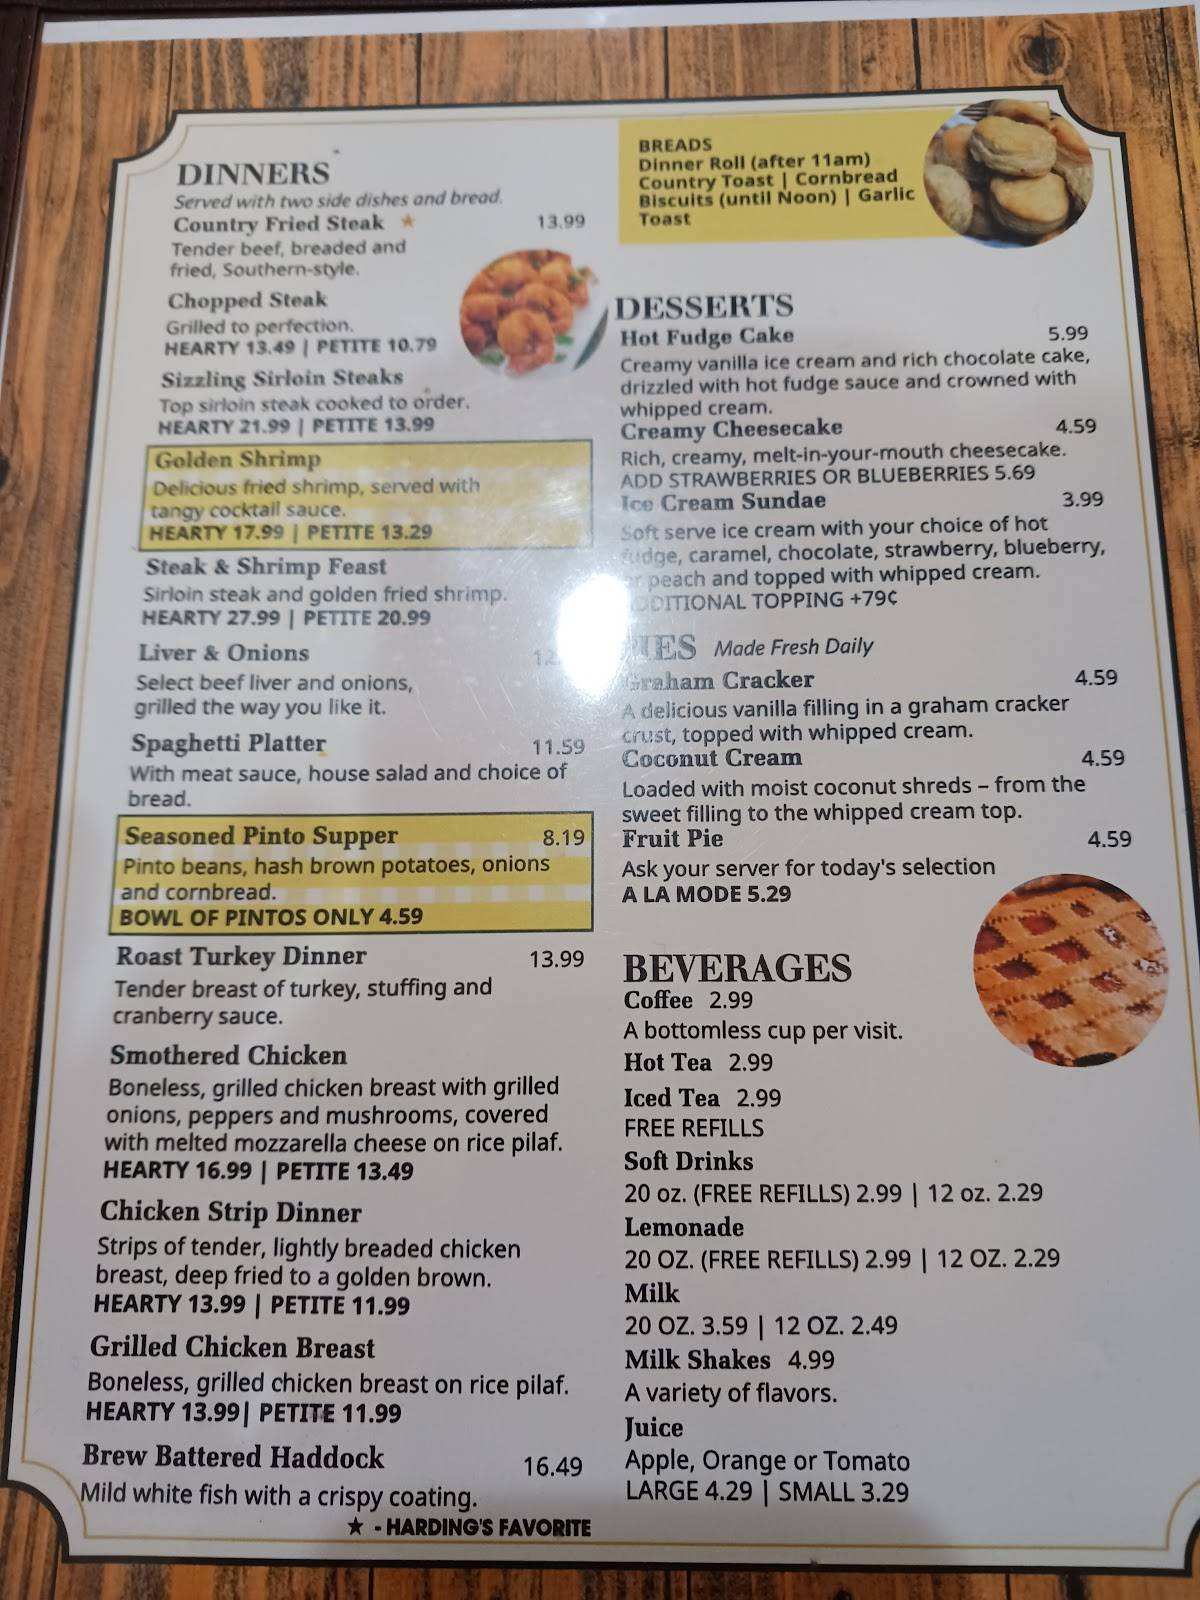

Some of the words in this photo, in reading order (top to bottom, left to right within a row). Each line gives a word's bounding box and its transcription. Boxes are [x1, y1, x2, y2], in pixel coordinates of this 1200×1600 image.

[639, 137, 712, 153] BREADS
[639, 156, 704, 172] Dinner
[709, 155, 745, 170] Roll
[751, 153, 806, 174] (after
[811, 152, 870, 173] 11am)
[177, 162, 329, 186] DINNERS
[173, 193, 233, 209] Served
[236, 193, 275, 209] with
[279, 195, 313, 208] two
[317, 192, 351, 208] side
[355, 191, 408, 207] dishes
[412, 190, 447, 206] and
[450, 188, 502, 205] bread.
[173, 216, 258, 237] Country
[265, 214, 319, 232] Fried
[326, 213, 384, 231] Steak
[538, 213, 585, 229] 13.99
[639, 211, 691, 226] Toast
[171, 241, 235, 257] Tender
[240, 240, 284, 257] beef,
[290, 239, 367, 256] breaded
[371, 239, 406, 254] and
[170, 262, 216, 279] fried,
[223, 260, 359, 280] Southern-style.
[168, 291, 262, 314] Chopped
[269, 290, 327, 307] Steak
[616, 294, 793, 320] DESSERTS
[165, 319, 225, 335] Grilled
[230, 321, 249, 334] to
[254, 317, 353, 337] perfection.
[621, 330, 659, 346] Hot
[667, 327, 732, 350] Fudge
[739, 325, 794, 343] Cake
[1048, 325, 1088, 341] 5.99
[161, 370, 246, 393] Sizzling
[252, 368, 325, 386] Sirloin
[333, 367, 403, 385] Steaks
[620, 375, 693, 395] drizzled
[698, 377, 739, 393] with
[746, 376, 777, 392] hot
[783, 374, 839, 395] fudge
[844, 377, 899, 390] sauce
[905, 373, 941, 389] and
[946, 370, 1029, 388] crowned
[1034, 369, 1076, 386] with
[620, 421, 706, 445] Creamy
[712, 416, 842, 438] Cheesecake
[1055, 418, 1096, 434] 4.59
[154, 450, 232, 469] Golden
[239, 448, 321, 473] Shrimp
[621, 449, 665, 469] Rich,
[671, 451, 746, 469] creamy,
[753, 442, 943, 467] melt-in-your-mouth
[949, 440, 1066, 459] cheesecake.
[621, 495, 653, 512] Ice
[660, 493, 734, 512] Cream
[741, 489, 826, 510] Sundae
[1062, 490, 1103, 507] 3.99
[145, 556, 206, 575] Steak
[213, 558, 229, 574] &
[237, 555, 321, 581] Shrimp
[328, 557, 387, 575] Feast
[714, 639, 765, 656] Made
[770, 638, 819, 655] Fresh
[825, 636, 874, 658] Daily
[722, 668, 815, 689] Cracker
[1074, 669, 1118, 686] 4.59
[131, 732, 240, 757] Spaghetti
[248, 732, 327, 751] Platter
[532, 738, 585, 755] 11.59
[621, 748, 718, 768] Coconut
[725, 747, 802, 766] Cream
[1081, 749, 1124, 766] 4.59
[125, 824, 235, 845] Seasoned
[242, 825, 305, 845] Pinto
[312, 825, 398, 850] Supper
[543, 829, 585, 846] 8.19
[622, 828, 680, 847] Fruit
[686, 828, 723, 847] Pie
[1087, 830, 1131, 848] 4.59
[621, 859, 658, 877] Ask
[662, 863, 710, 882] your
[715, 863, 779, 877] server
[784, 858, 815, 876] for
[820, 857, 896, 880] today's
[902, 856, 995, 875] selection
[621, 886, 637, 902] A
[643, 885, 670, 902] LA
[676, 885, 741, 902] MODE
[747, 885, 791, 902] 5.29
[119, 909, 183, 926] BOWL
[190, 909, 219, 926] OF
[225, 908, 306, 926] PINTOS
[313, 908, 374, 925] ONLY
[378, 907, 423, 925] 4.59
[116, 946, 182, 965] Roast
[189, 945, 276, 972] Turkey
[282, 945, 367, 965] Dinner
[530, 950, 584, 967] 13.99
[622, 953, 852, 983] BEVERAGES
[624, 989, 692, 1009] Coffee
[709, 991, 752, 1008] 2.99
[110, 1043, 240, 1065] Smothered
[248, 1043, 347, 1065] Chicken
[624, 1052, 664, 1071] Hot
[670, 1052, 712, 1071] Tea
[729, 1053, 773, 1071] 2.99
[624, 1086, 672, 1107] Iced
[678, 1088, 720, 1107] Tea
[737, 1088, 781, 1107] 2.99
[625, 1118, 675, 1137] FREE
[682, 1118, 764, 1137] REFILLS
[624, 1149, 669, 1170] Soft
[675, 1150, 753, 1170] Drinks
[100, 1198, 200, 1221] Chicken
[208, 1200, 268, 1228] Strip
[275, 1201, 362, 1222] Dinner
[624, 1215, 744, 1236] Lemonade
[97, 1236, 157, 1260] Strips
[164, 1235, 187, 1255] of
[191, 1235, 265, 1259] tender,
[273, 1236, 339, 1262] lightly
[345, 1237, 433, 1258] breaded
[440, 1238, 520, 1258] chicken
[624, 1281, 680, 1302] Milk
[90, 1333, 177, 1357] Grilled
[185, 1334, 287, 1358] Chicken
[295, 1336, 375, 1358] Breast
[625, 1348, 680, 1369] Milk
[687, 1348, 771, 1369] Shakes
[788, 1350, 834, 1369] 4.99
[624, 1416, 683, 1441] Juice
[81, 1443, 147, 1465] Brew
[154, 1443, 261, 1467] Battered
[269, 1444, 384, 1469] Haddock
[524, 1456, 582, 1476] 16.49
[625, 1447, 694, 1475] Apple,
[702, 1449, 786, 1476] Orange
[793, 1454, 818, 1470] or
[822, 1450, 910, 1471] Tomato
[79, 1481, 126, 1506] Mild
[132, 1482, 192, 1504] white
[199, 1483, 237, 1505] fish
[244, 1483, 290, 1505] with
[298, 1490, 310, 1506] a
[317, 1485, 383, 1512] crispy
[389, 1485, 477, 1513] coating.
[386, 1517, 493, 1536] HARDING'S
[498, 1518, 591, 1537] FAVORITE
